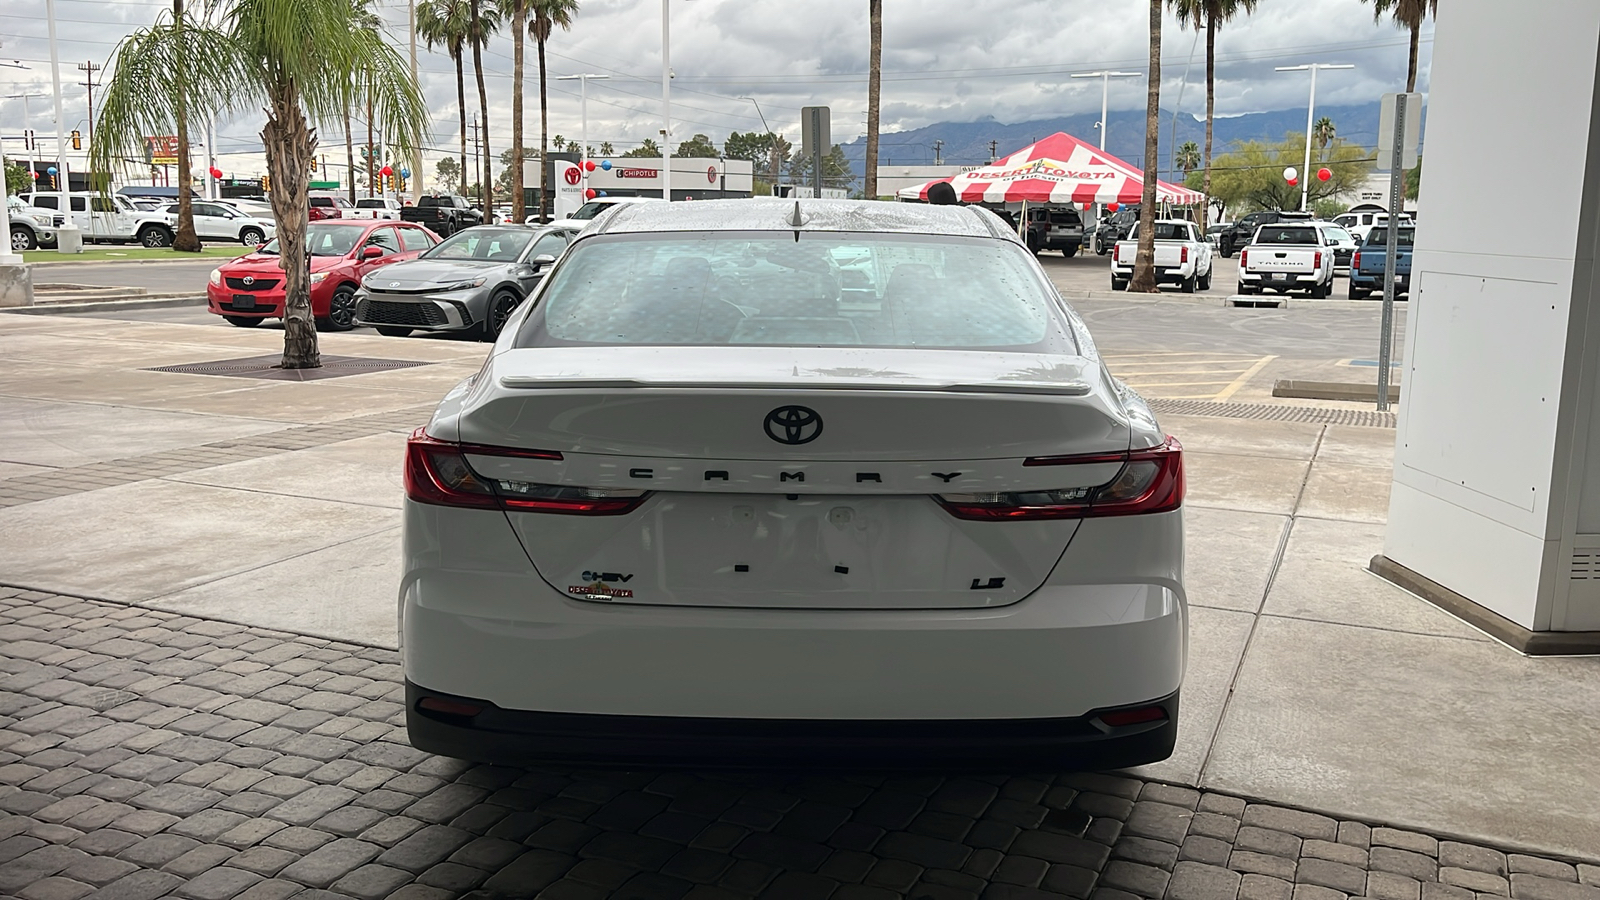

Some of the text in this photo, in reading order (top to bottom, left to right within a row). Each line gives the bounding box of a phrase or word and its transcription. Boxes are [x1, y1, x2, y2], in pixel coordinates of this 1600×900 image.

[966, 166, 1116, 180] DESERT TOYOTA
[629, 467, 962, 483] CAMRY
[970, 577, 1006, 590] LE
